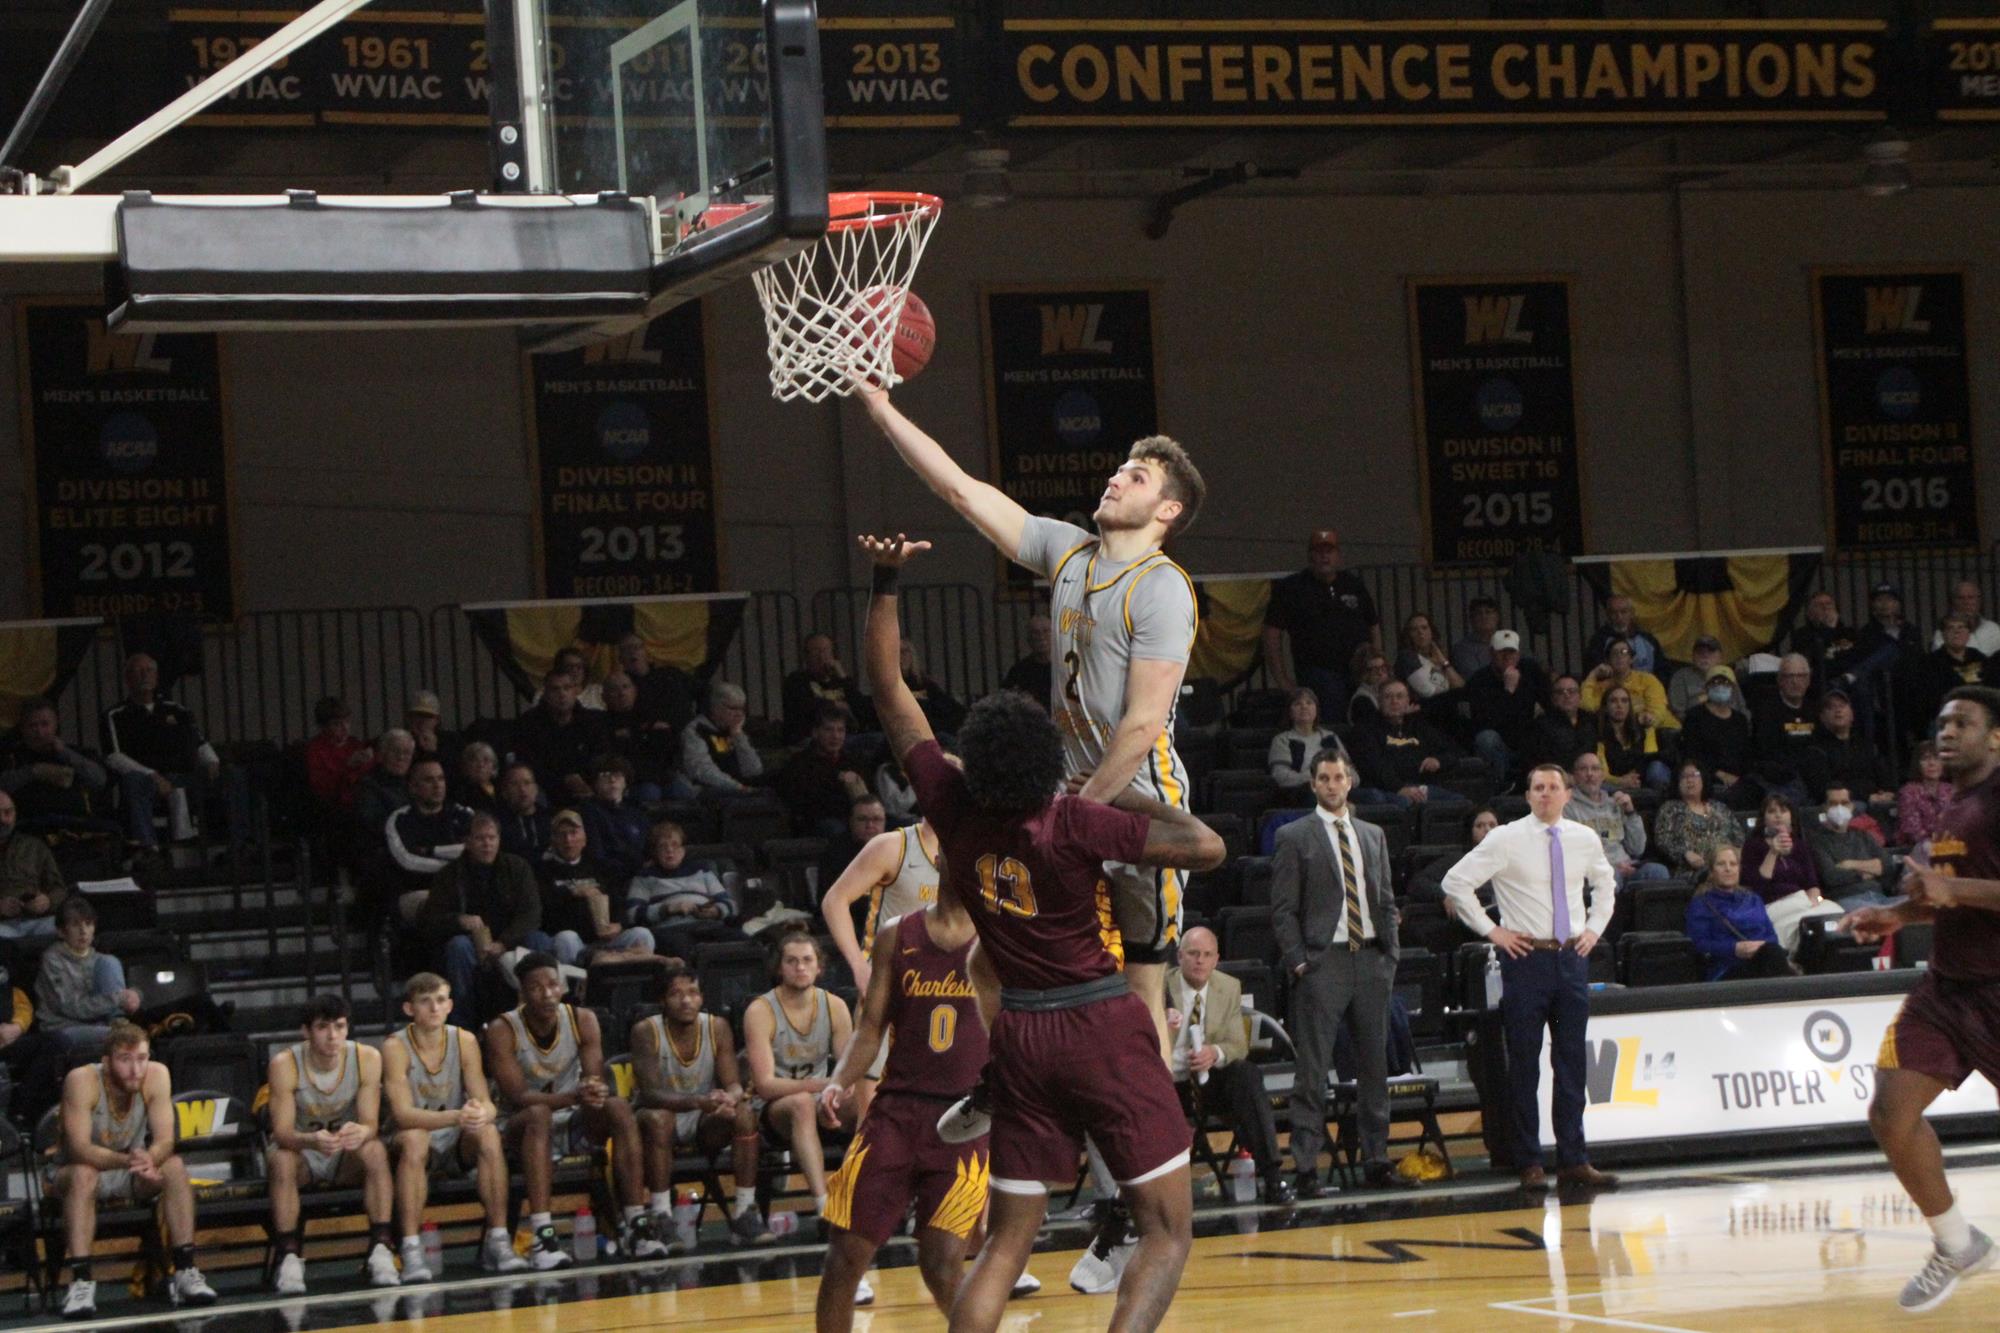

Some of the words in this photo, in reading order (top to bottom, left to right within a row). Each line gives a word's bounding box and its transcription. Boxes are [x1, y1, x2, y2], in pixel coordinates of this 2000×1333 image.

[342, 36, 431, 70] 1961
[852, 43, 942, 74] 2013
[332, 73, 442, 99] WVIAC
[1016, 43, 1475, 102] CONFERENCE
[1490, 42, 1877, 99] CHAMPIONS
[847, 78, 949, 103] WVIAC
[1040, 303, 1113, 355] WL
[1004, 368, 1047, 383] MEN'S
[1051, 366, 1145, 381] BASKETBALL
[1430, 358, 1472, 371] MEN'S
[1476, 355, 1563, 369] BASKETBALL
[43, 388, 95, 403] MEN'S
[101, 386, 210, 402] BASKETBALL
[545, 379, 592, 393] MEN'S
[596, 377, 696, 391] BASKETBALL
[1443, 436, 1543, 456] DIVISION
[558, 464, 672, 486] DIVISION
[678, 463, 696, 484] II
[1018, 449, 1118, 473] DIVISION
[1451, 461, 1527, 481] SWEET
[58, 479, 183, 500] DIVISION
[551, 489, 627, 512] FINAL
[635, 489, 706, 511] FOUR
[1861, 475, 1950, 511] 2016
[52, 507, 128, 528] ELITE
[136, 503, 217, 527] EIGHT
[1463, 490, 1553, 528] 2015
[578, 525, 686, 562] 2013
[79, 541, 196, 580] 2012
[1064, 651, 1080, 704] 2
[976, 853, 1038, 917] 13
[928, 1003, 958, 1053] 0
[1712, 1065, 1826, 1111] TOPPER
[175, 1097, 239, 1139] WL
